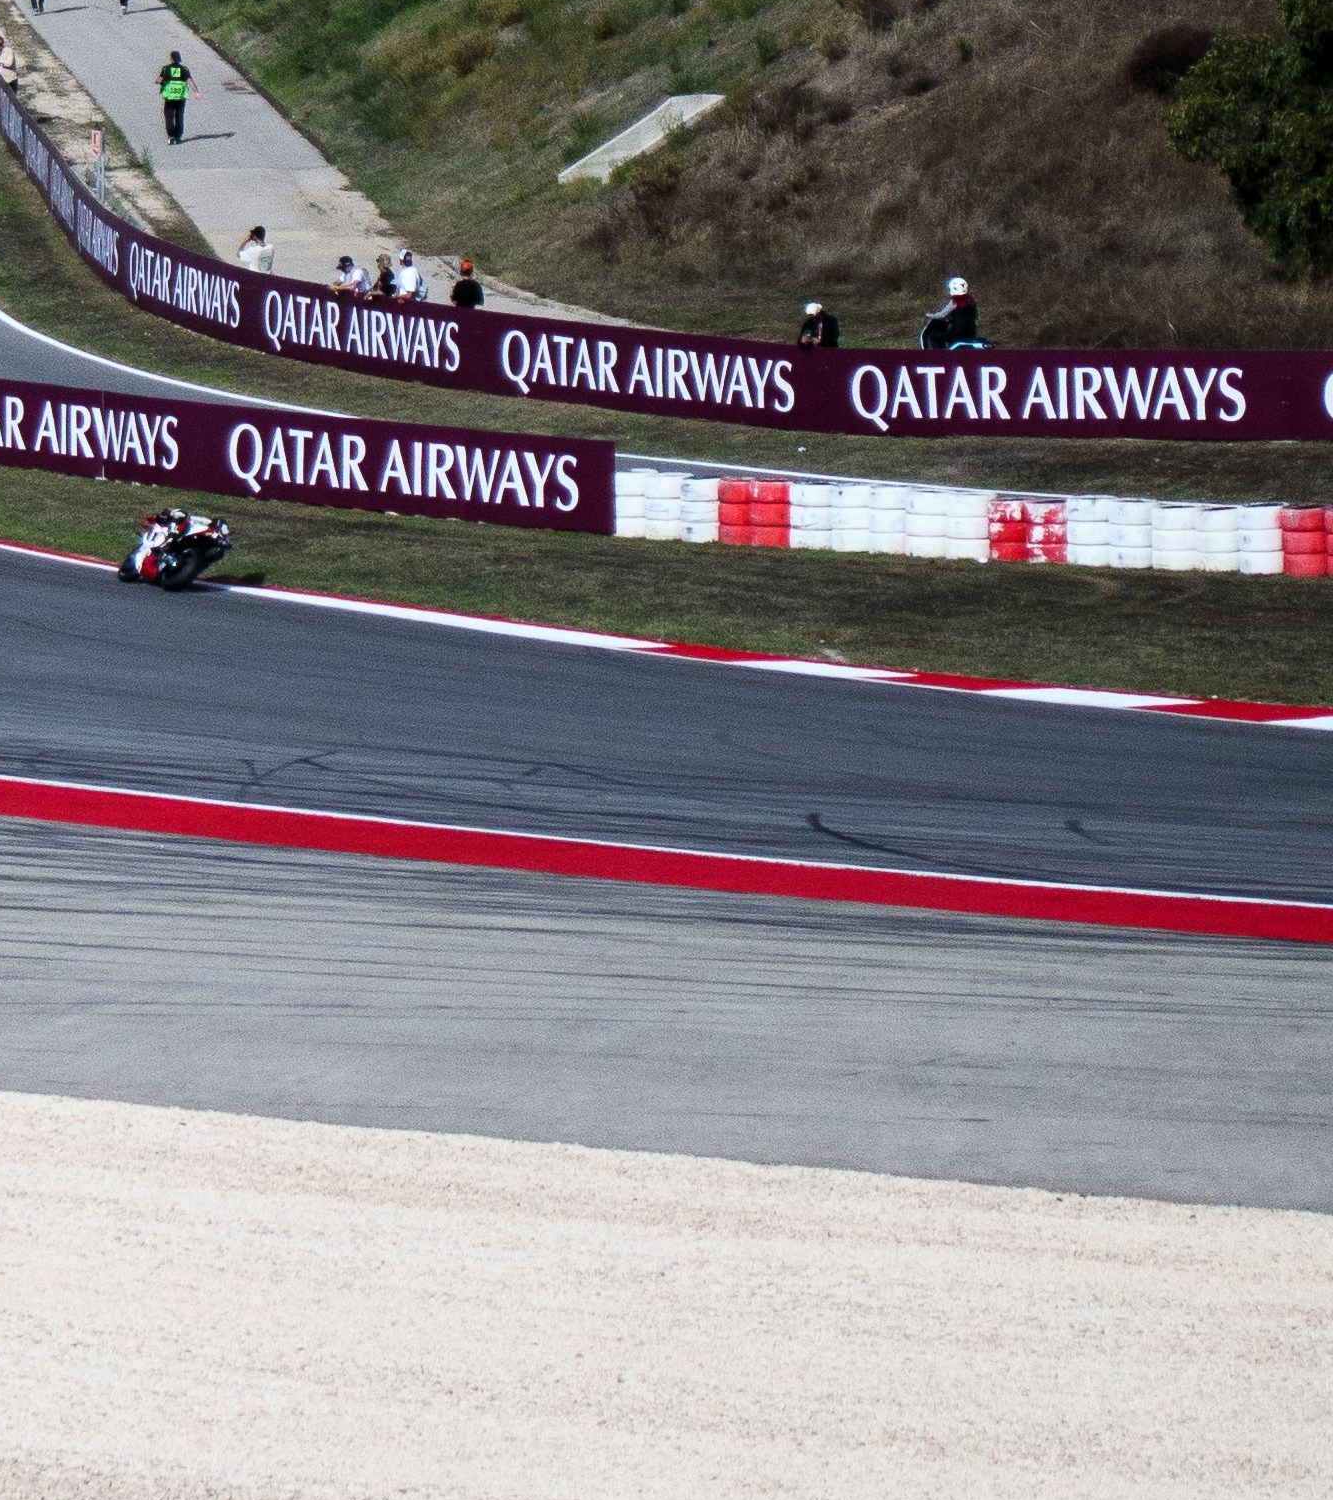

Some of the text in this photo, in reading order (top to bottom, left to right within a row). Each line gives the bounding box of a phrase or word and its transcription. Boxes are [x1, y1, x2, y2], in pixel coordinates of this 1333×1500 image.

[128, 240, 172, 300] QATAR
[174, 266, 240, 329] AIRWAYS
[264, 290, 341, 352] QATAR
[346, 310, 460, 373] AIRWAYS
[501, 330, 618, 394] QATAR
[628, 347, 795, 413] AIRWAYS
[851, 364, 1012, 431] QATAR
[1022, 366, 1247, 423] AIRWAYS
[34, 401, 179, 471] AIRWAYS
[229, 423, 369, 493] QATAR
[380, 440, 580, 512] AIRWAYS
